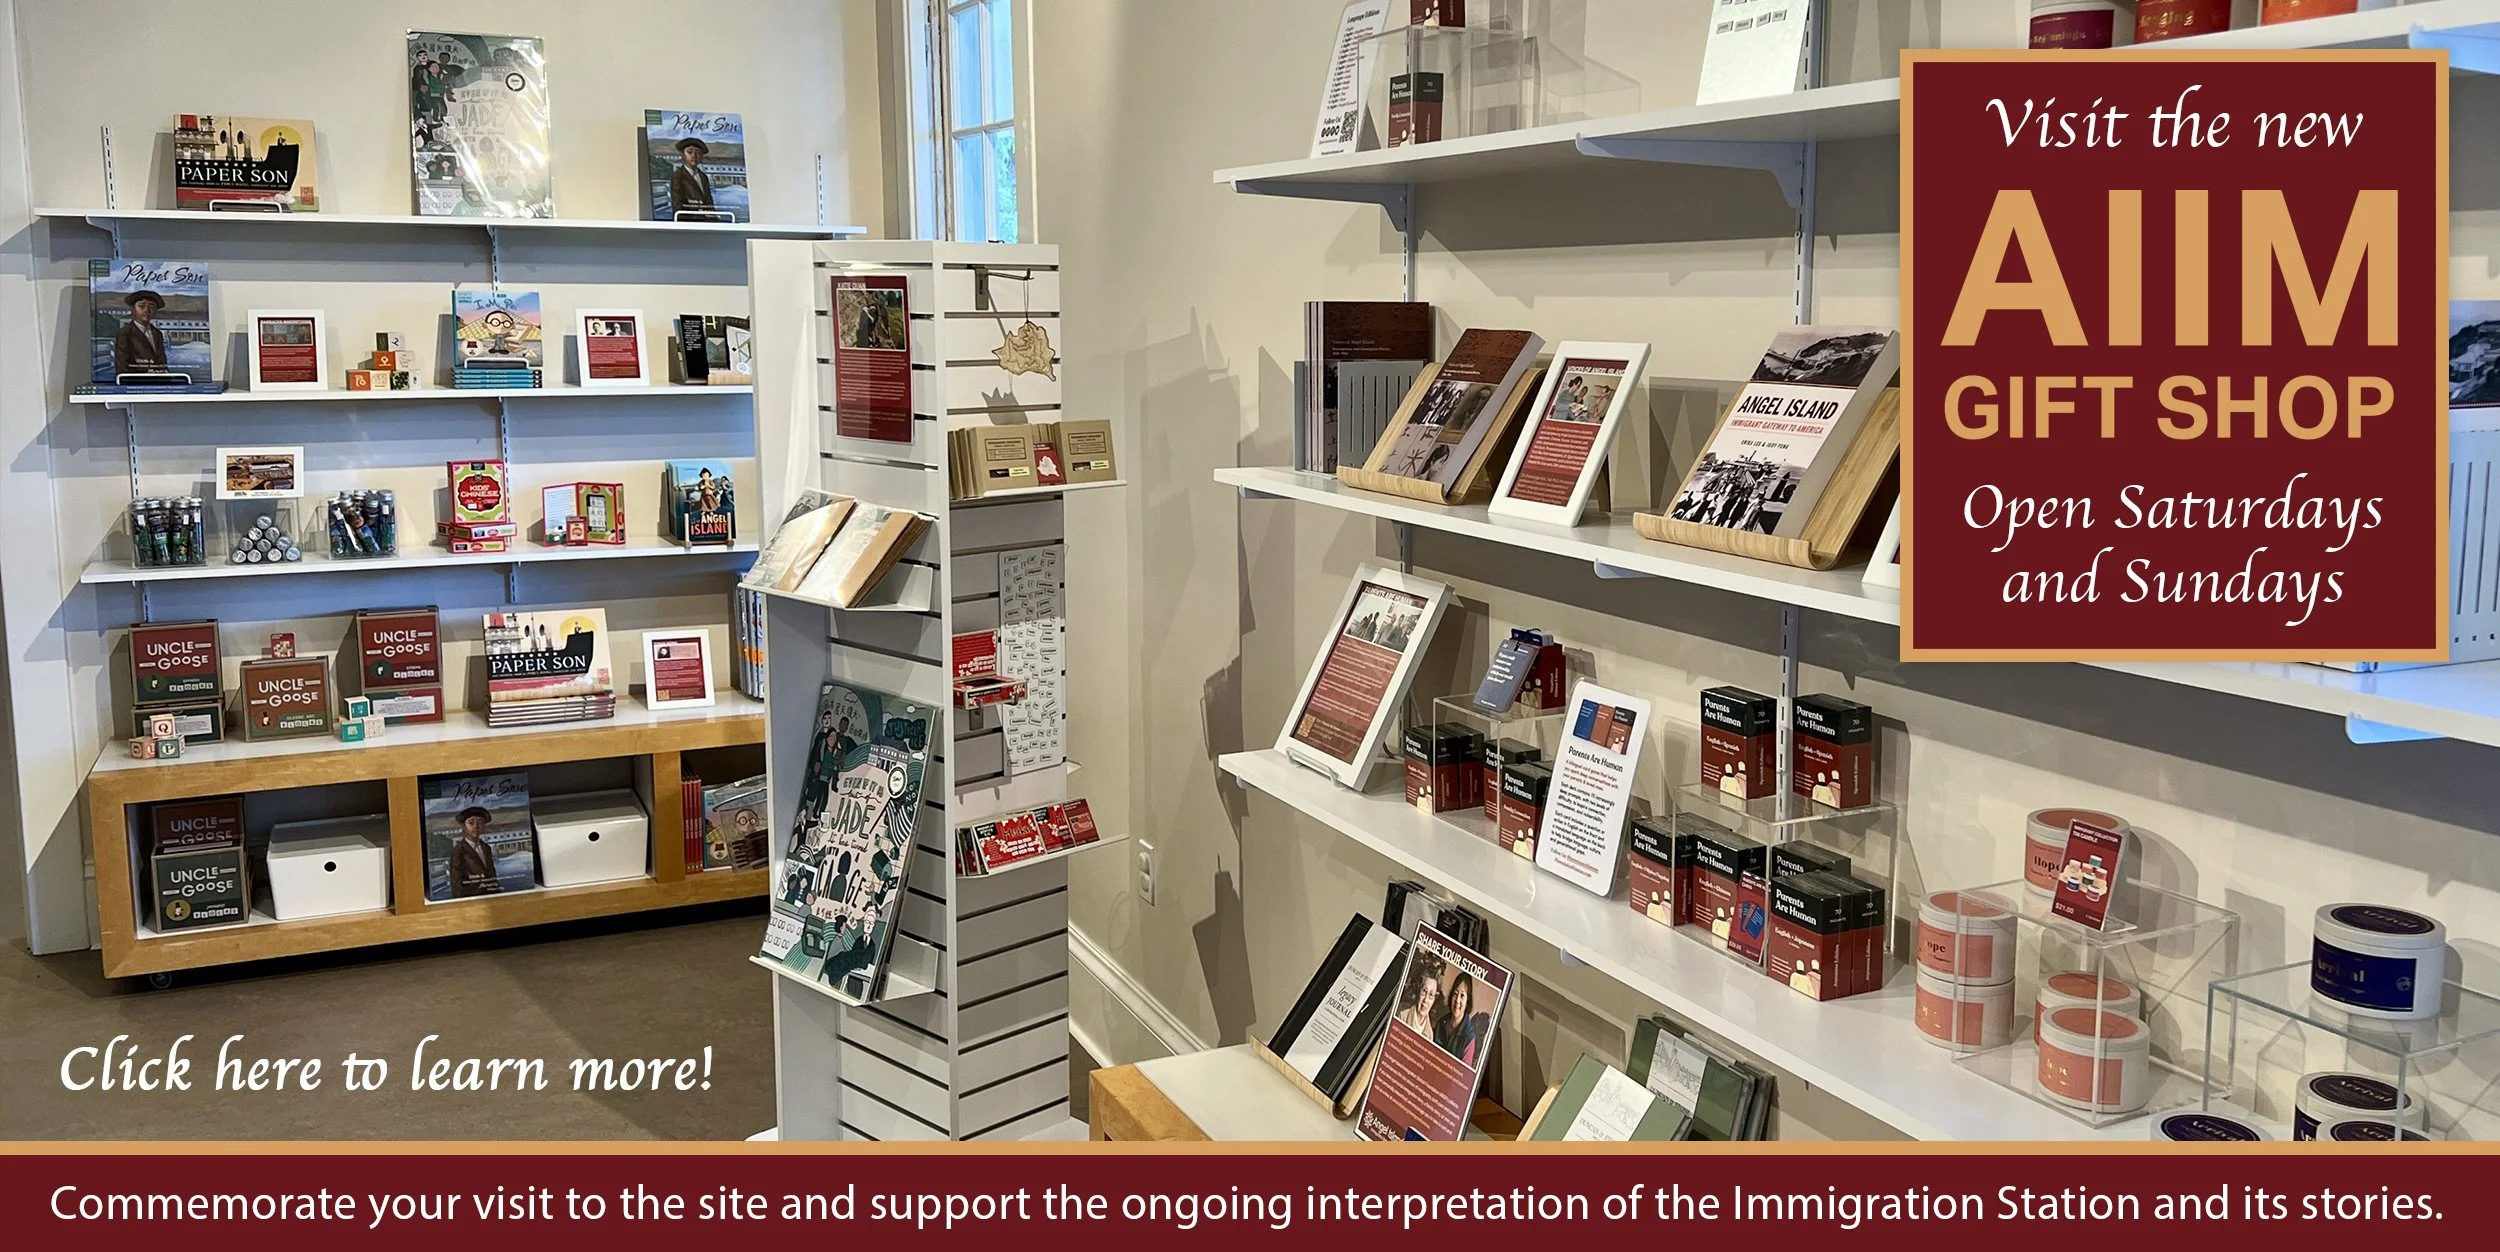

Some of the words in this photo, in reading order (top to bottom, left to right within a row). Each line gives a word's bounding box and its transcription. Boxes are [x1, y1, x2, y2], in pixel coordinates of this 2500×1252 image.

[458, 103, 504, 127] JADE
[672, 114, 710, 133] Paper
[712, 117, 737, 132] Son
[181, 166, 244, 182] PAPER
[251, 169, 288, 183] SON
[122, 264, 169, 286] Paper
[172, 267, 203, 283] Son
[1737, 395, 1785, 416] ANGEL
[1784, 398, 1839, 420] ISLAND
[1732, 419, 1762, 430] IMMIGRANT
[1762, 421, 1789, 432] GATEWAY
[1788, 423, 1796, 433] TO
[1796, 423, 1824, 434] AMERICA
[701, 514, 727, 523] ANGEL
[374, 630, 416, 643] UNCLE
[147, 641, 194, 656] UNCLE
[383, 643, 430, 657] GOOSE
[158, 655, 208, 670] GOOSE
[492, 658, 547, 673] PAPER
[553, 655, 586, 669] SON
[259, 679, 304, 693] UNCLE
[269, 692, 318, 707] GOOSE
[1704, 697, 1730, 714] Parents
[1704, 708, 1717, 720] Are
[1717, 712, 1742, 728] Human
[1796, 705, 1823, 722] Parents
[158, 723, 169, 733] Q
[1796, 717, 1809, 728] Are
[1809, 721, 1835, 736] Human
[1405, 736, 1422, 750] Parents
[1706, 735, 1721, 746] English
[1724, 740, 1740, 752] Spanish
[1412, 747, 1428, 760] Human
[1568, 746, 1590, 760] Parents
[1590, 754, 1600, 764] Are
[1601, 757, 1623, 772] Human
[1816, 749, 1833, 760] Spanish
[1505, 772, 1524, 787] Parents
[452, 782, 494, 802] Paper
[496, 779, 523, 796] Son
[1504, 783, 1513, 794] Are
[1513, 786, 1532, 800] Human
[171, 817, 217, 832] UNCLE
[831, 797, 876, 839] JADE
[182, 830, 232, 844] GOOSE
[1634, 828, 1658, 846] Parents
[2073, 825, 2094, 835] IMMIGRANT
[2094, 831, 2118, 843] COLLECTION
[2081, 833, 2098, 843] CANDLE
[1634, 837, 1646, 851] Are
[1645, 842, 1668, 861] Human
[1696, 841, 1722, 860] Parents
[1696, 851, 1709, 863] Are
[1709, 855, 1734, 875] Human
[1776, 855, 1804, 873] Parents
[1776, 865, 1789, 877] Are
[171, 867, 218, 883] UNCLE
[181, 880, 233, 897] GOOSE
[1698, 877, 1713, 888] English
[1716, 884, 1731, 897] Chinese
[1775, 889, 1805, 909] Parents
[1774, 899, 1789, 914] Are
[1789, 904, 1817, 926] Human
[1834, 908, 1842, 916] 70
[2055, 902, 2074, 914] $21.00
[2363, 909, 2418, 928] Arrival
[1774, 927, 1791, 939] English
[1793, 934, 1815, 950] Japanese
[1417, 932, 1441, 955] SHARE
[1441, 944, 1462, 966] YOUR
[1461, 957, 1489, 980] STORY
[2317, 958, 2365, 983] Arrial
[1337, 986, 1356, 1005] legacy
[1326, 996, 1352, 1019] JOURNAL
[2340, 1080, 2393, 1102] Arrival
[1372, 1117, 1389, 1134] Angel
